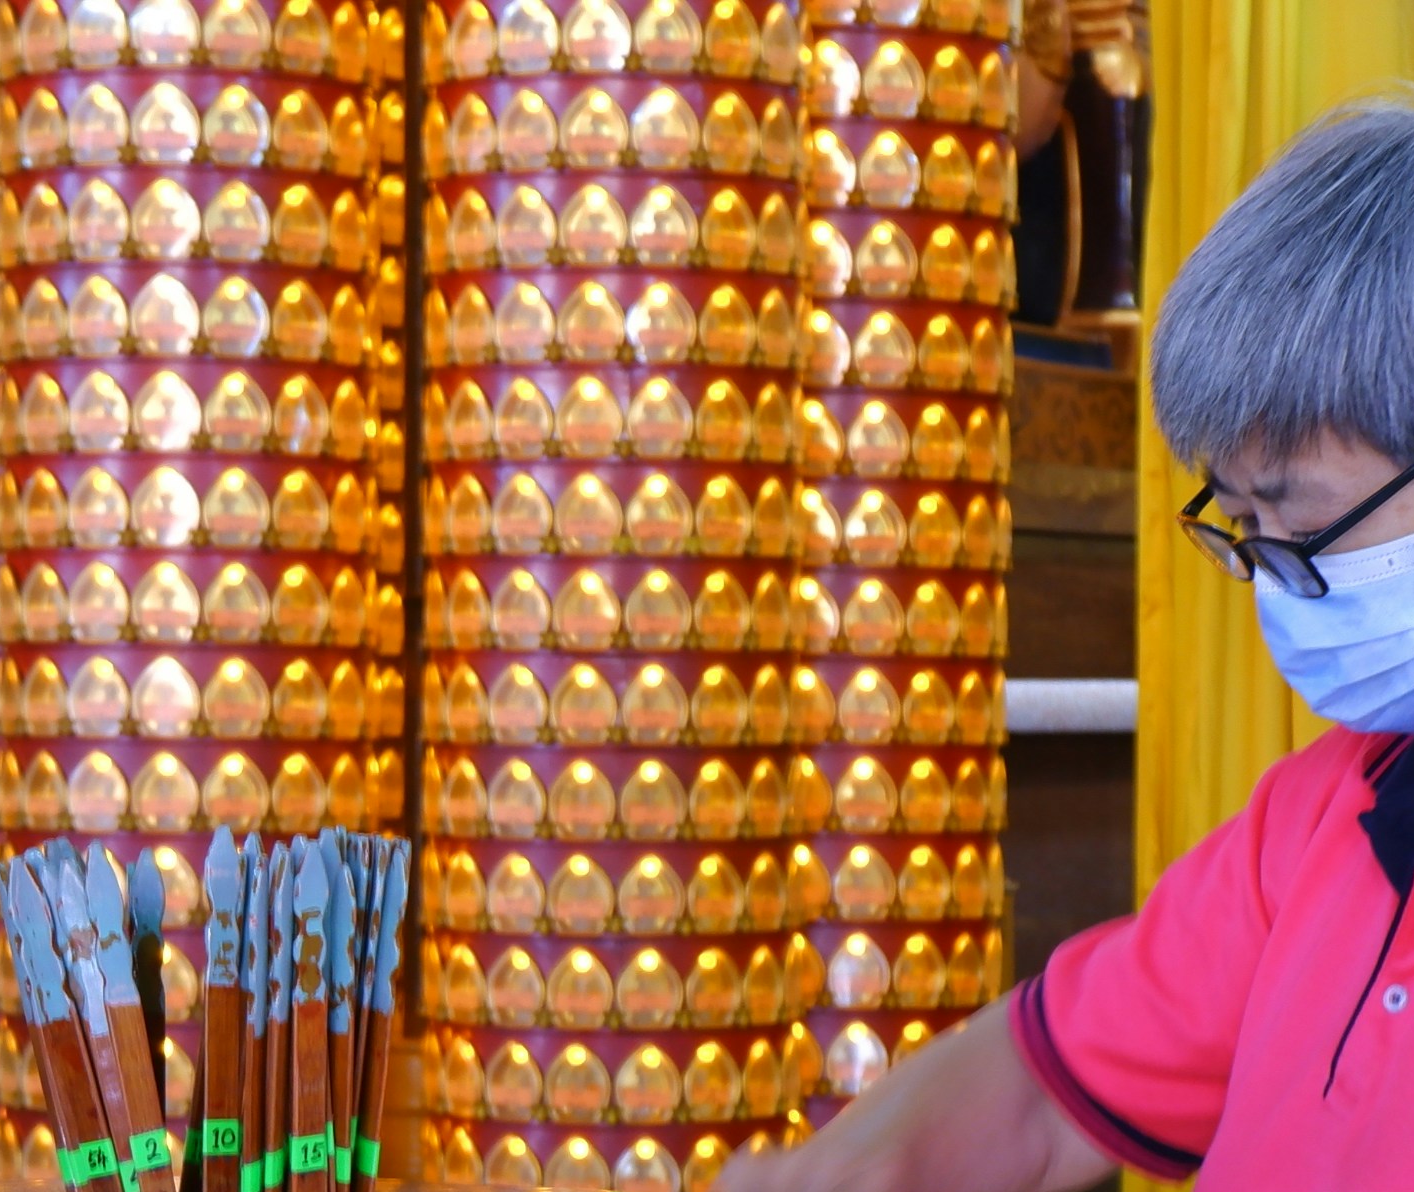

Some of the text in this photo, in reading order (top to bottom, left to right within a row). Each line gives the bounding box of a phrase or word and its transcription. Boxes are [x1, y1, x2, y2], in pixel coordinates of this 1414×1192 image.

[212, 1127, 236, 1148] 10
[146, 1138, 161, 1163] 2
[301, 1142, 321, 1164] 15
